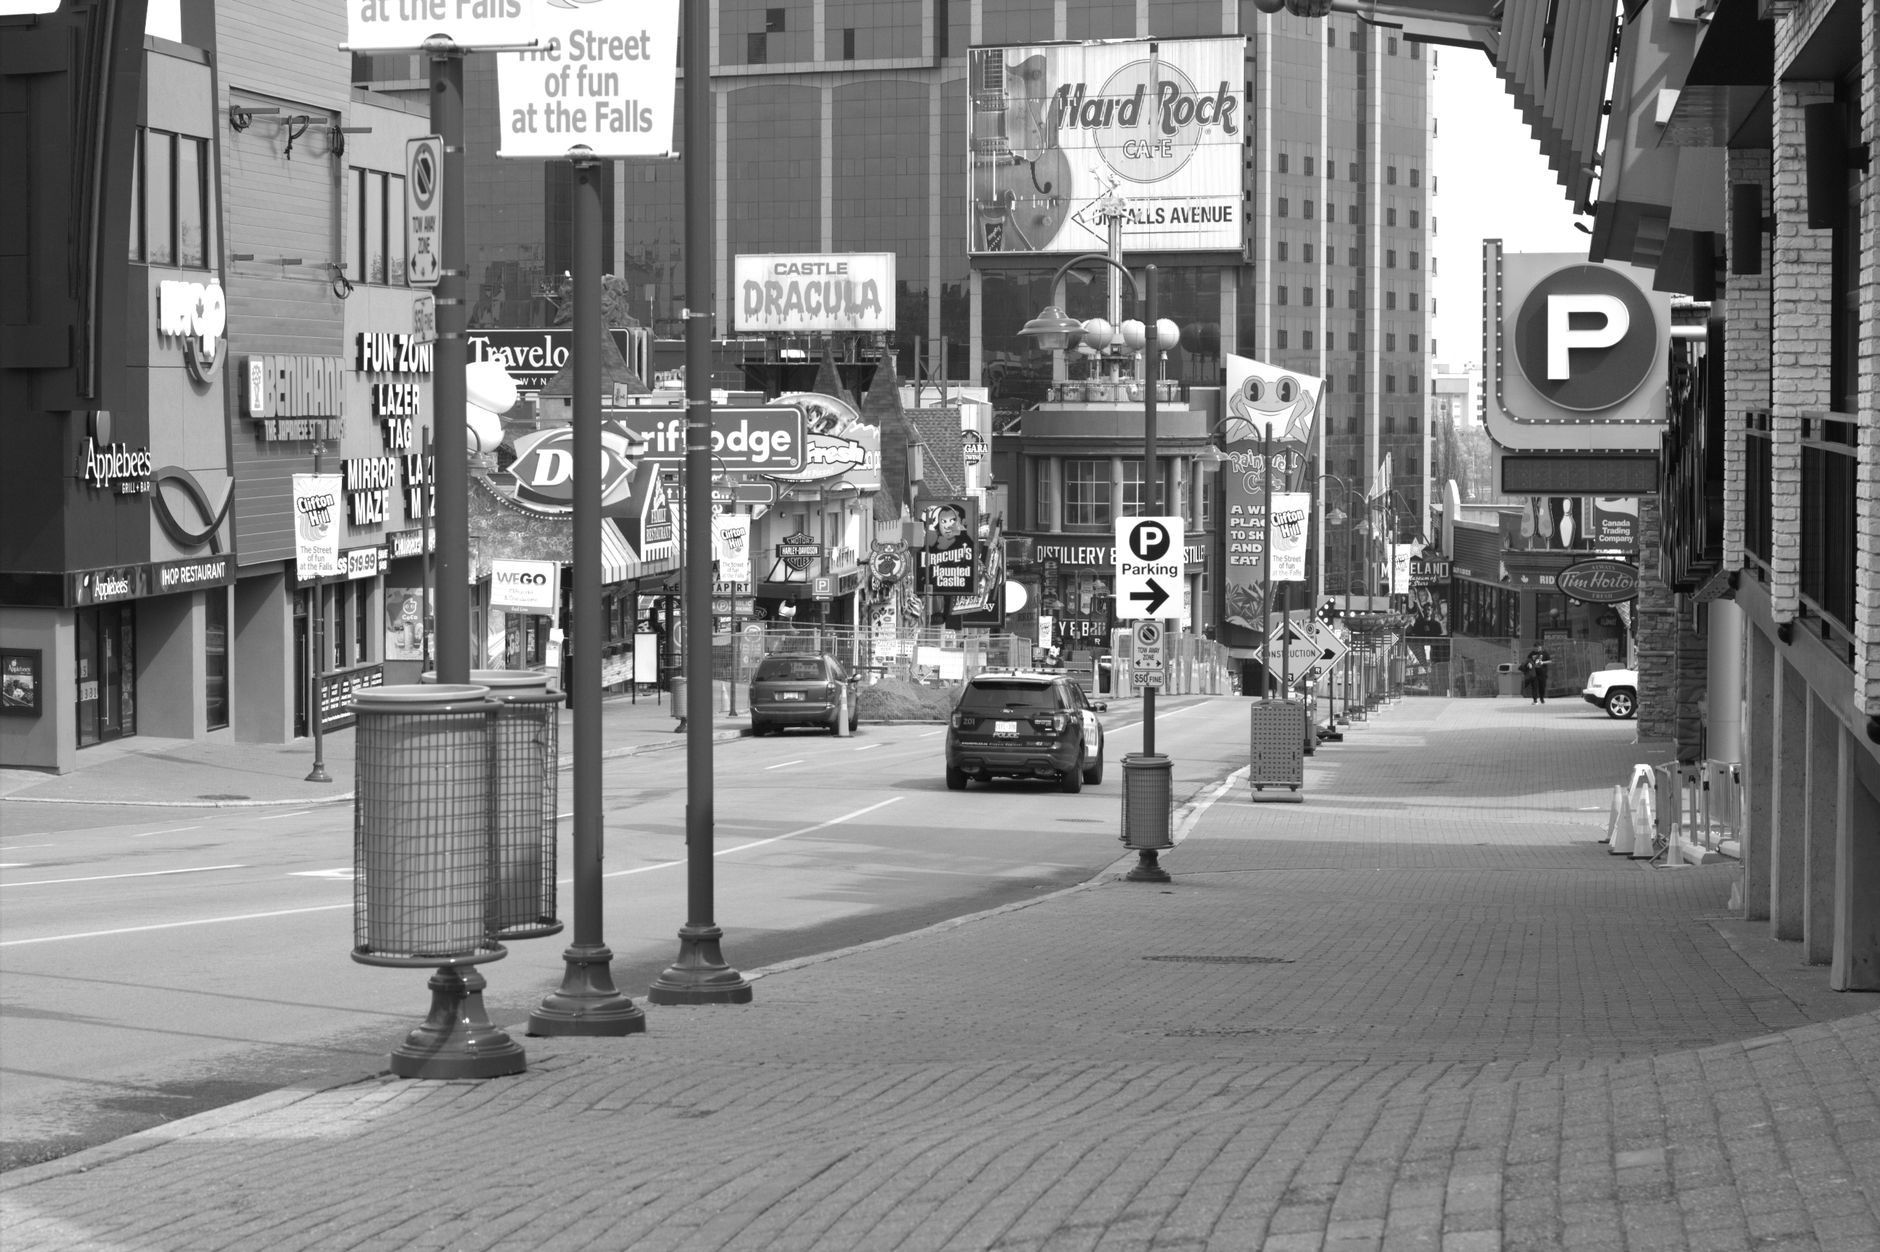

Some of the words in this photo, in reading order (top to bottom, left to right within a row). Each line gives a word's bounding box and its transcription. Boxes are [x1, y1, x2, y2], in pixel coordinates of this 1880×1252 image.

[361, 0, 390, 23] at
[399, 0, 446, 21] the
[456, 0, 522, 20] Falls
[569, 29, 651, 62] Street
[544, 64, 571, 98] of
[577, 64, 619, 97] fun
[511, 103, 538, 134] at
[544, 101, 587, 134] the
[595, 99, 653, 134] Falls
[1057, 82, 1147, 130] Hard
[1147, 80, 1239, 137] Rock
[1169, 205, 1233, 224] AVENUE
[774, 262, 848, 276] CASTLE
[743, 278, 882, 325] DRACULA
[1547, 294, 1630, 380] P
[363, 332, 395, 372] FUN
[399, 333, 434, 373] ZON
[467, 334, 570, 368] Travelo
[378, 383, 420, 416] LAZER
[387, 417, 413, 449] TAG
[964, 443, 988, 454] GARA
[85, 436, 151, 488] Applebee's
[347, 456, 396, 491] MIRROR
[121, 482, 136, 494] GRILL
[140, 481, 151, 494] BAR
[296, 493, 335, 514] Clifton
[354, 489, 390, 526] MAZE
[1230, 505, 1243, 514] A
[1247, 505, 1266, 514] WI
[307, 507, 331, 527] Hill
[1271, 509, 1305, 527] Clifton
[1602, 519, 1631, 527] Canada
[720, 527, 746, 540] Clifton
[1230, 530, 1246, 540] TO
[1248, 530, 1265, 540] SH
[1280, 523, 1301, 539] Hill
[1602, 527, 1631, 536] Trading
[728, 537, 744, 550] Hill
[1140, 526, 1163, 555] P
[1598, 535, 1634, 544] Company
[300, 545, 311, 554] The
[312, 545, 332, 554] Street
[1037, 545, 1106, 565] DISTILLERY
[1230, 543, 1263, 553] AND
[307, 554, 314, 562] of
[315, 554, 325, 562] fun
[307, 561, 318, 571] the
[318, 561, 333, 571] Falls
[349, 553, 376, 573] $19.99
[1230, 556, 1259, 565] EAT
[162, 567, 179, 586] IHOP
[180, 562, 226, 584] RESTAURANT
[932, 565, 971, 578] Haunted
[1122, 563, 1178, 578] Parking
[1381, 562, 1449, 578] MELAND
[496, 571, 547, 586] WEGO
[937, 576, 966, 588] Castle
[1539, 575, 1556, 585] RID
[1561, 571, 1588, 588] Tim
[94, 575, 128, 600] Applebee's
[1261, 649, 1317, 659] NSUCTION
[1134, 673, 1149, 684] $50
[1149, 675, 1163, 683] FINE
[963, 717, 976, 726] 201
